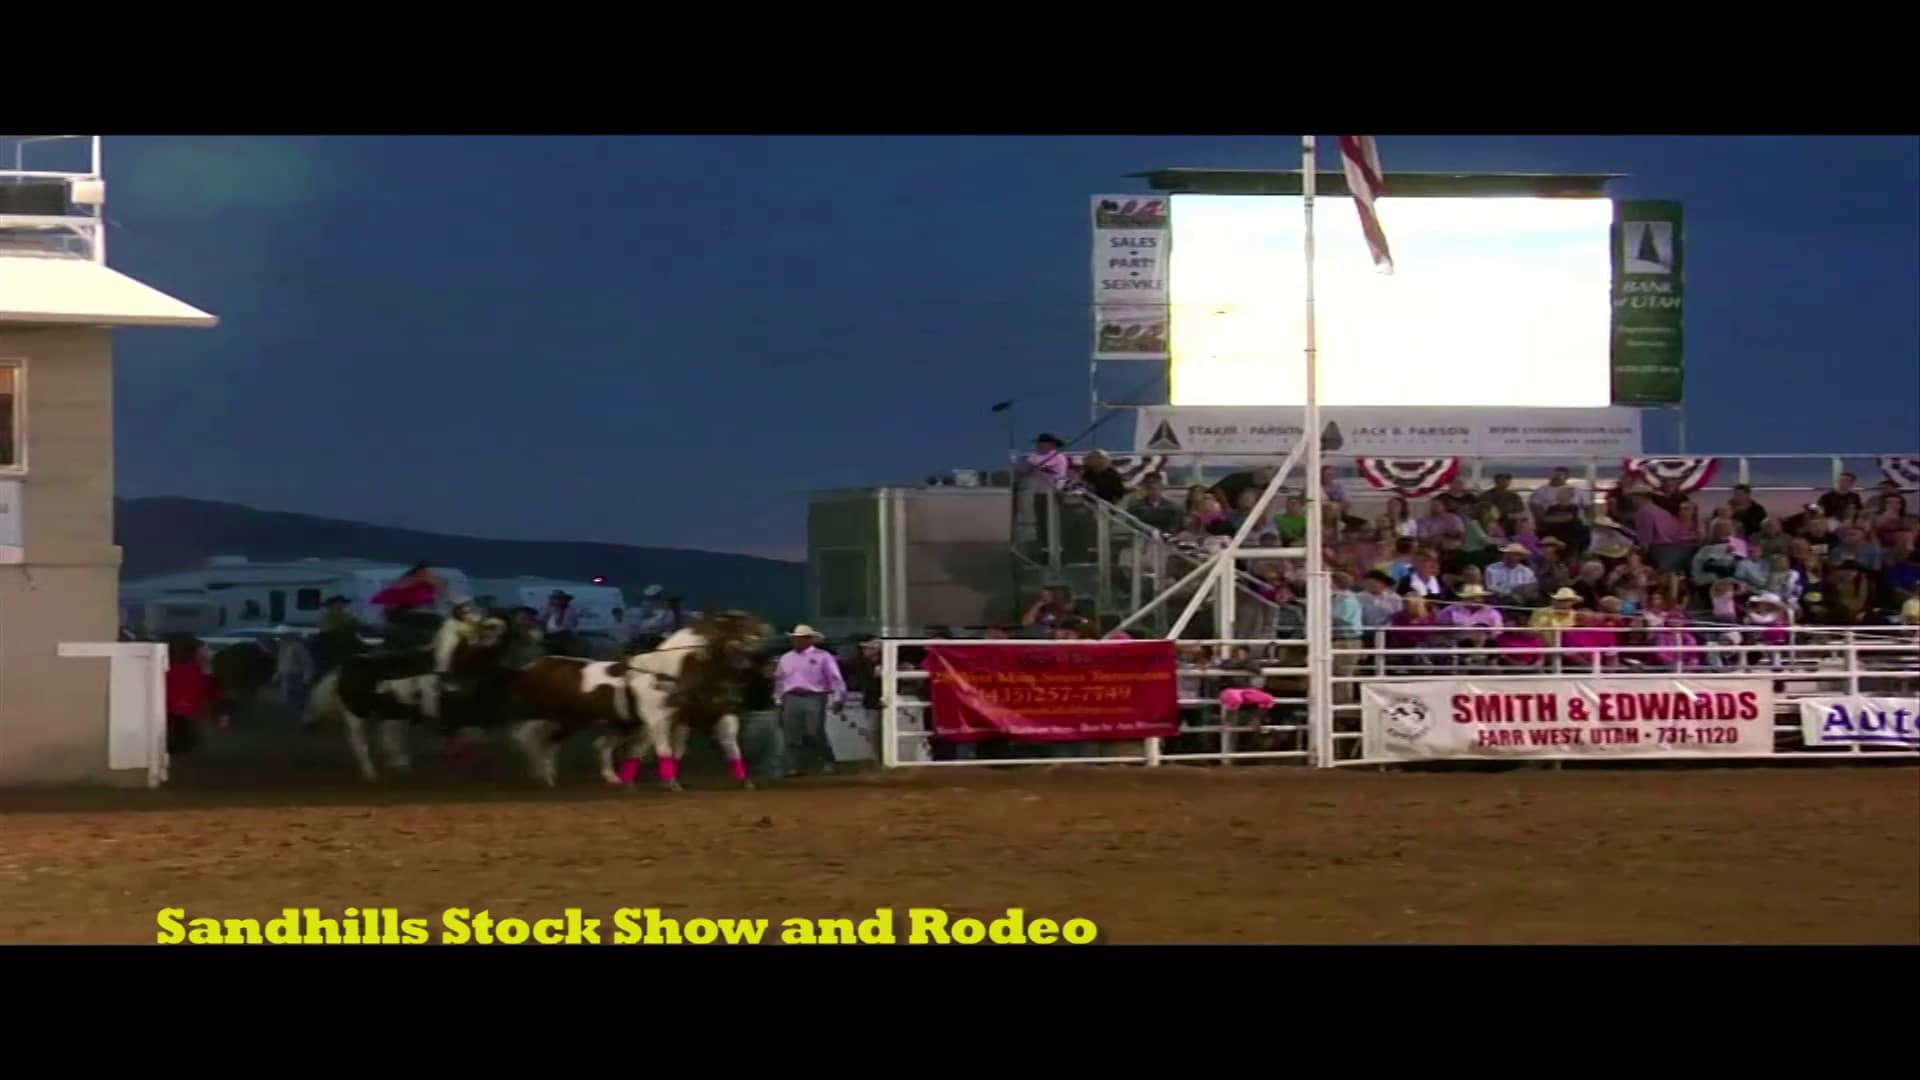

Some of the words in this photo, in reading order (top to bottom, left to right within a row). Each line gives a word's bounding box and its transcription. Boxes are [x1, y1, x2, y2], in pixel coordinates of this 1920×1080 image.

[1110, 237, 1157, 248] SALES
[1452, 693, 1558, 723] SMITH
[1568, 697, 1590, 721] &
[1598, 691, 1759, 721] EDWARDS
[1478, 729, 1525, 747] FARR
[1589, 727, 1640, 745] UTAH
[1656, 726, 1738, 744] 731-1120
